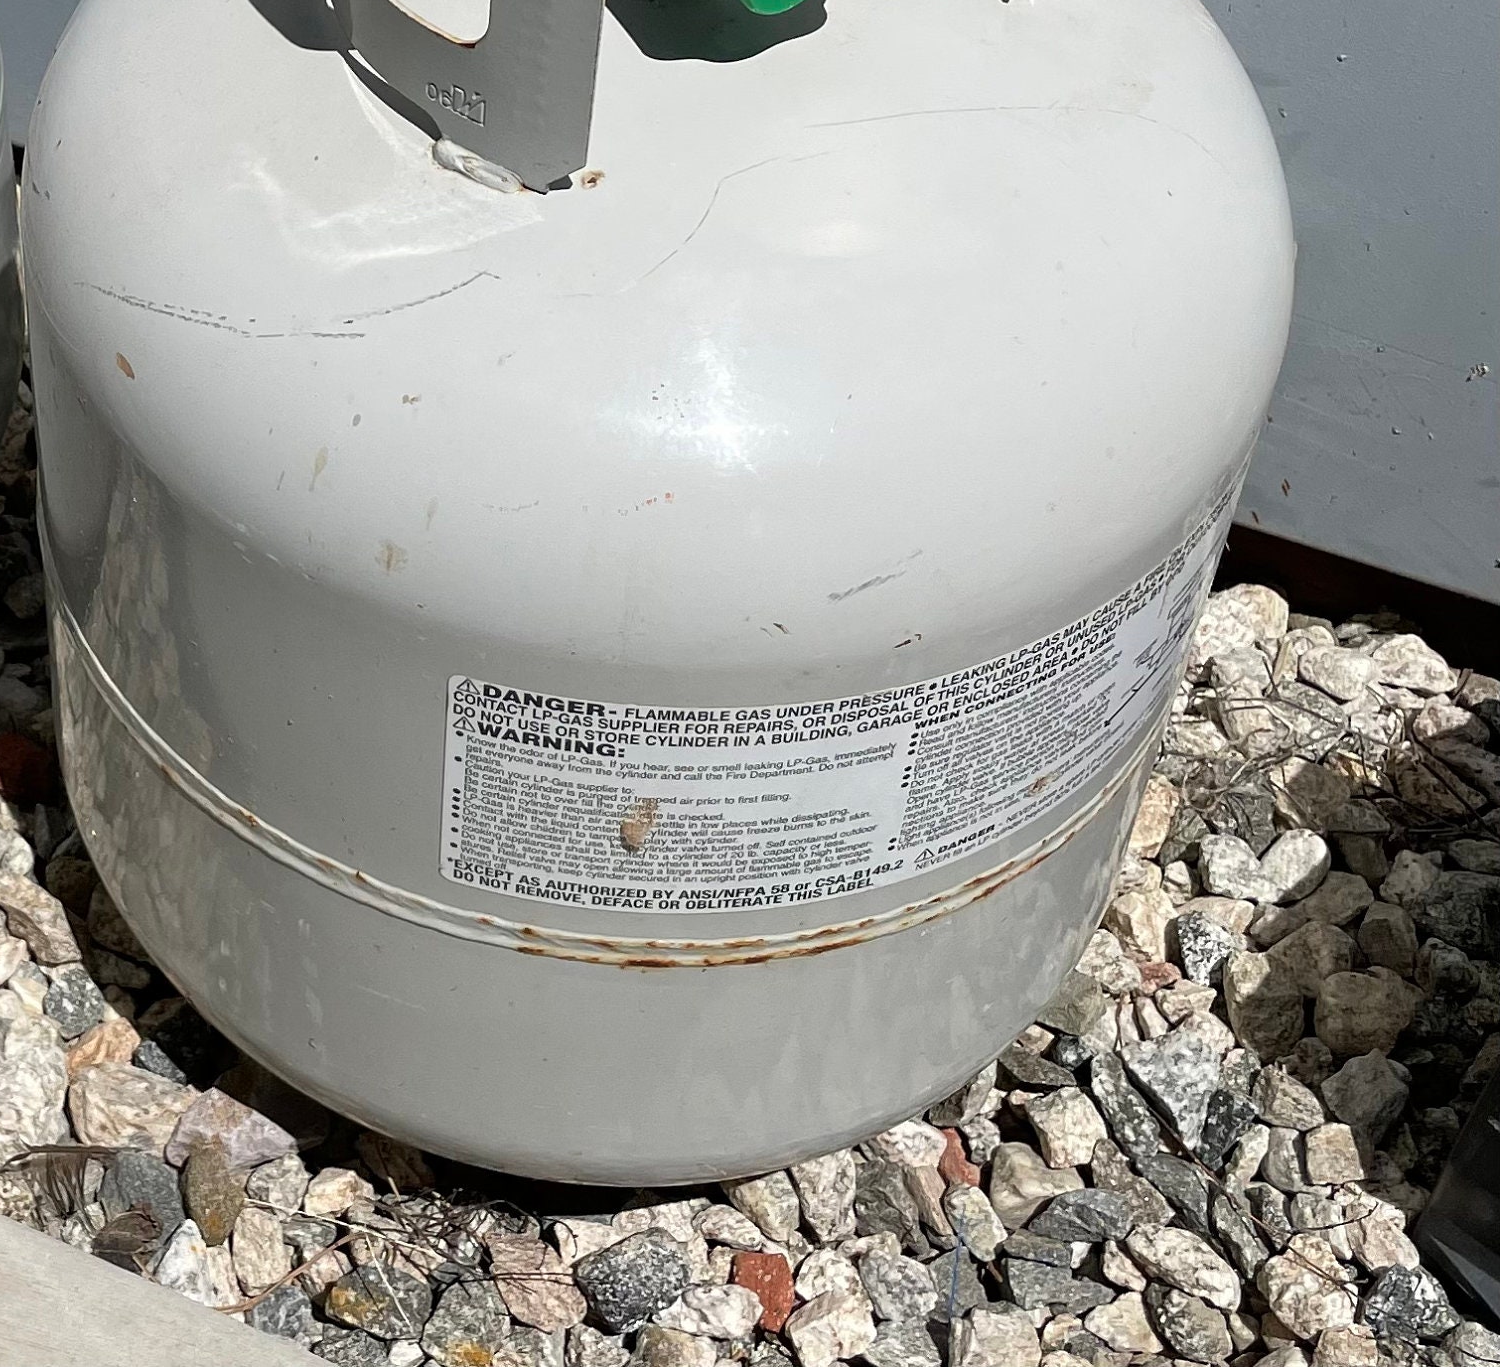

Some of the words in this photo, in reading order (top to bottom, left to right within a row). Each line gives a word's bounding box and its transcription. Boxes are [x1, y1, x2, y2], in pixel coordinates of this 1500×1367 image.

[453, 691, 528, 716] CONTACT
[532, 708, 593, 727] LP-GAS
[597, 719, 680, 734] SUPPLIER
[685, 724, 719, 733] FOR
[724, 720, 798, 733] REPAIRS,
[802, 716, 826, 728] OR
[831, 702, 909, 725] DISPOSAL
[914, 693, 935, 707] OF
[938, 683, 970, 700] THIS
[974, 653, 1042, 689] CYLINDER
[1045, 641, 1064, 658] OR
[1067, 612, 1115, 647] UNUSED
[1119, 582, 1156, 614] LP-GAS
[453, 704, 475, 717] DO
[480, 710, 512, 727] NOT
[518, 720, 550, 733] USE
[555, 726, 579, 738] OR
[584, 728, 640, 744] STORE
[645, 735, 729, 747] CYLINDER
[734, 736, 749, 746] IN
[755, 735, 766, 745] A
[771, 725, 852, 745] BUILDING,
[857, 709, 923, 732] GARAGE
[927, 702, 949, 717] OR
[953, 673, 1028, 709] ENCLOSED
[1032, 651, 1067, 676] AREA
[1081, 632, 1099, 650] DO
[1101, 617, 1124, 636] NOT
[1126, 598, 1147, 619] FILL
[624, 708, 731, 722] FLAMMABLE
[735, 709, 771, 720] GAS
[777, 702, 835, 719] UNDER
[839, 684, 926, 712] PRESSURE
[941, 659, 1006, 688] LEAKING
[1009, 633, 1060, 665] LP-GAS
[1063, 618, 1089, 639] MAY
[1092, 590, 1131, 621] CAUSE
[1134, 582, 1141, 593] A
[915, 710, 959, 729] WHEN
[964, 670, 1056, 714] CONNECTING
[1061, 652, 1086, 671] FOR
[466, 735, 496, 749] Know
[500, 744, 516, 752] the
[519, 748, 544, 757] odor
[744, 760, 783, 771] leaking
[834, 742, 897, 761] immediately
[477, 721, 625, 758] WARNING:
[938, 825, 995, 854] DANGER
[453, 869, 474, 881] DO
[479, 877, 511, 891] NOT
[515, 884, 586, 905] REMOVE,
[592, 896, 653, 909] DEFACE
[659, 900, 679, 909] OR
[686, 894, 782, 910] OBLITERATE
[788, 888, 822, 902] THIS
[828, 878, 874, 895] LABEL
[519, 876, 540, 886] AS
[546, 880, 647, 898] AUTHORIZED
[652, 890, 674, 899] BY
[679, 886, 765, 899] ANSI/NFPA
[771, 883, 790, 893] 58
[794, 882, 809, 890] or
[816, 860, 904, 887] CSA-B149.2
